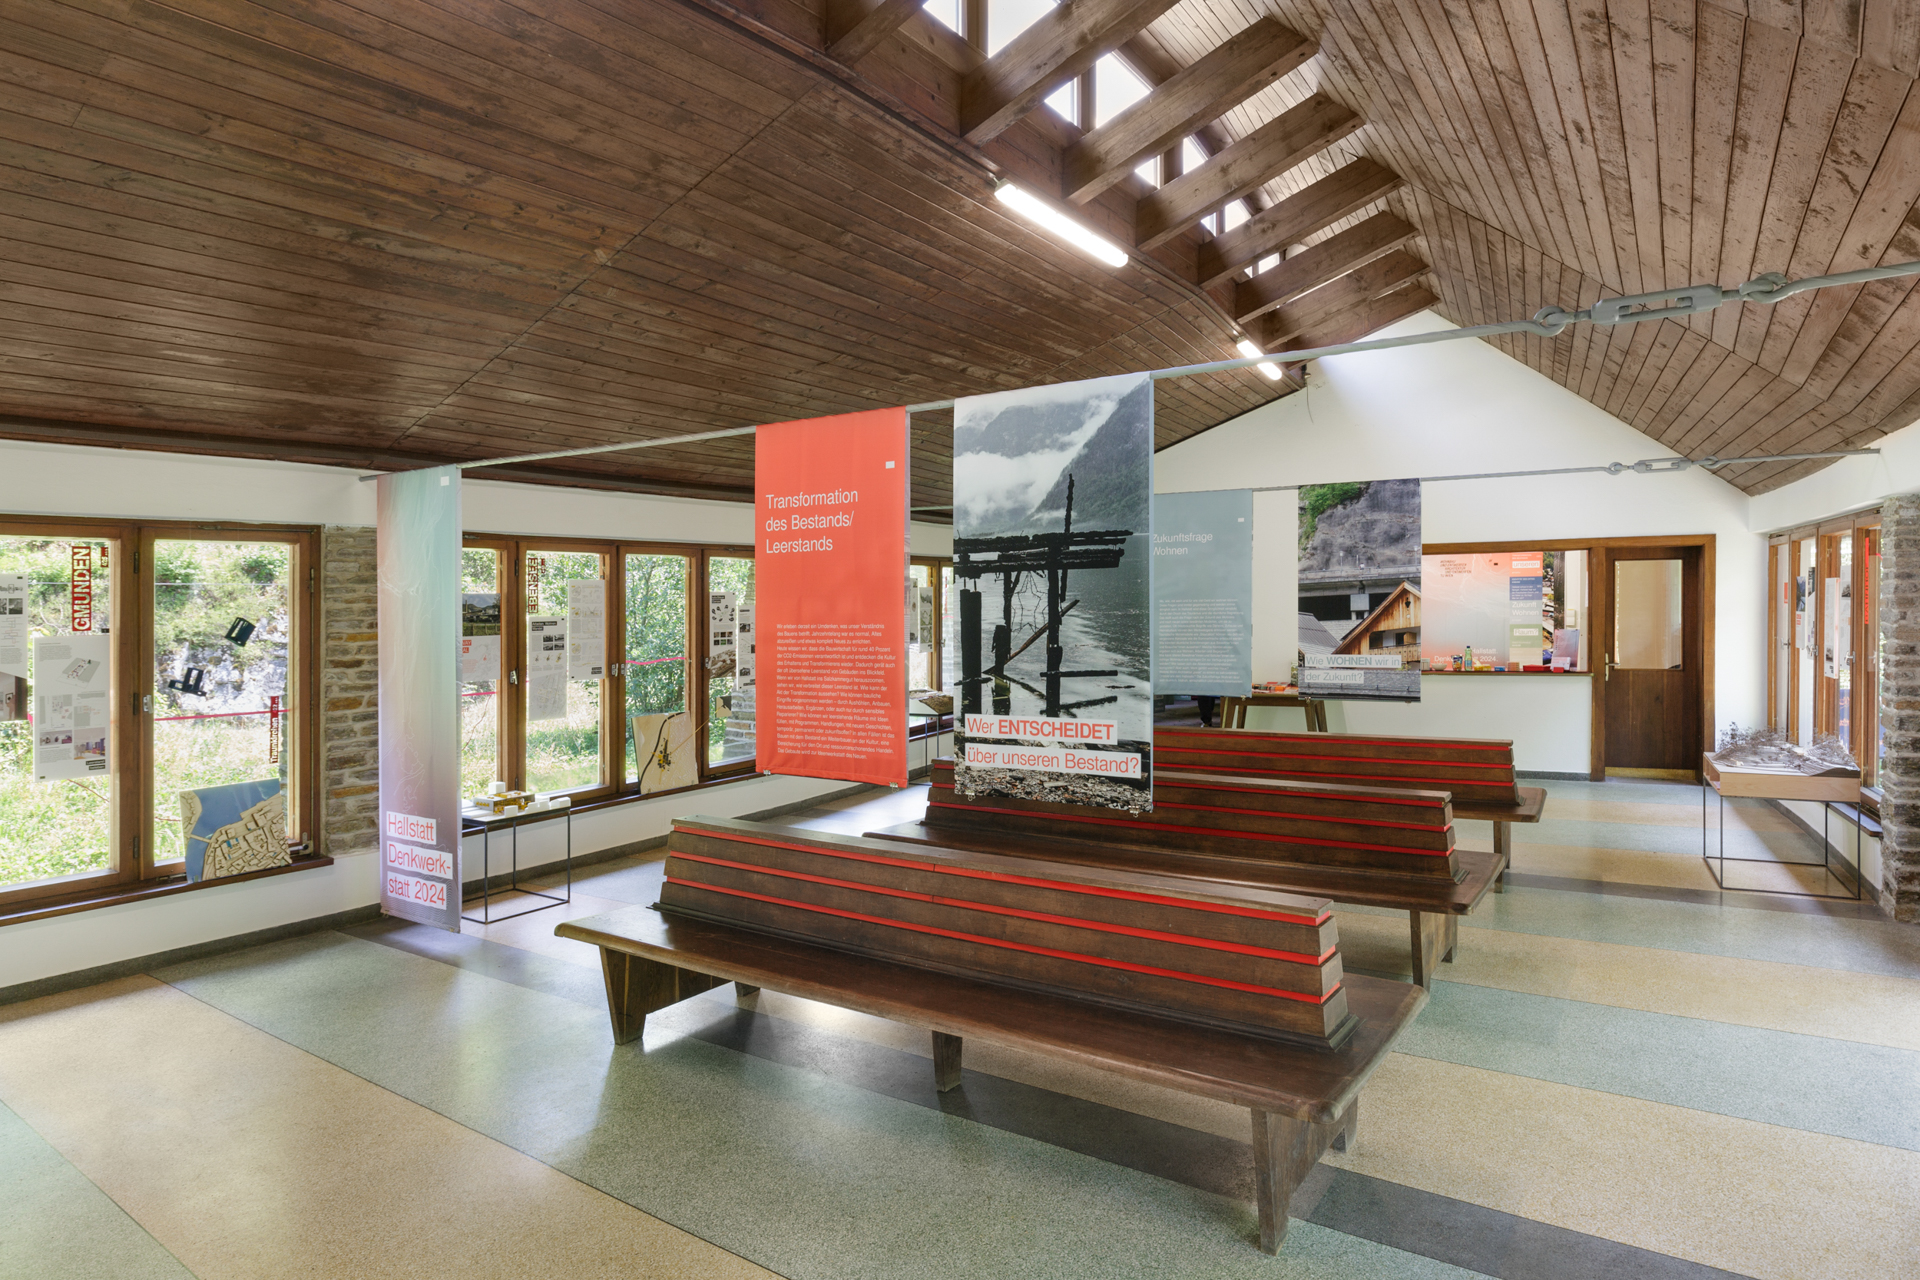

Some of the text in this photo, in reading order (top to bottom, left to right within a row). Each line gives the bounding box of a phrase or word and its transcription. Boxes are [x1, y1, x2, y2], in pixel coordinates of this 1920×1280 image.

[765, 488, 858, 509] Transformation
[765, 510, 854, 532] des Bestands/
[766, 535, 833, 554] Leerstands
[1152, 532, 1213, 543] Zukunftsfrage
[1152, 546, 1188, 556] Wohnen
[73, 548, 91, 631] GMUNDEN
[528, 558, 538, 613] EBENSEE
[1306, 656, 1400, 666] Wie WOHNEN wir in
[824, 676, 853, 684] Salzkammergut
[854, 677, 885, 685] herauszoomen,
[1305, 672, 1363, 681] der Zukunft?
[776, 704, 805, 712] Herausarbeiten,
[806, 705, 825, 713] Ergänzen,
[849, 699, 871, 707] Aushöhlen,
[872, 701, 891, 709] Anbauen,
[776, 711, 798, 719] Reparieren?
[776, 718, 788, 726] füllen,
[795, 719, 820, 727] Programmen,
[821, 721, 845, 729] Handlungen,
[865, 723, 892, 732] Geschichten,
[825, 728, 852, 736] zukunftsoffen?
[967, 717, 1115, 740] Wer ENTSCHEIDET
[270, 717, 278, 763] Traunkirchen
[777, 740, 801, 748] Bereicherung
[831, 744, 875, 753] ressourcenschonendes
[818, 750, 845, 758] Ideenwerkstatt
[967, 747, 1139, 774] über unseren Bestand?
[388, 813, 434, 842] Hallstatt
[388, 843, 451, 875] Denkwerk-
[388, 876, 446, 906] statt 2024
